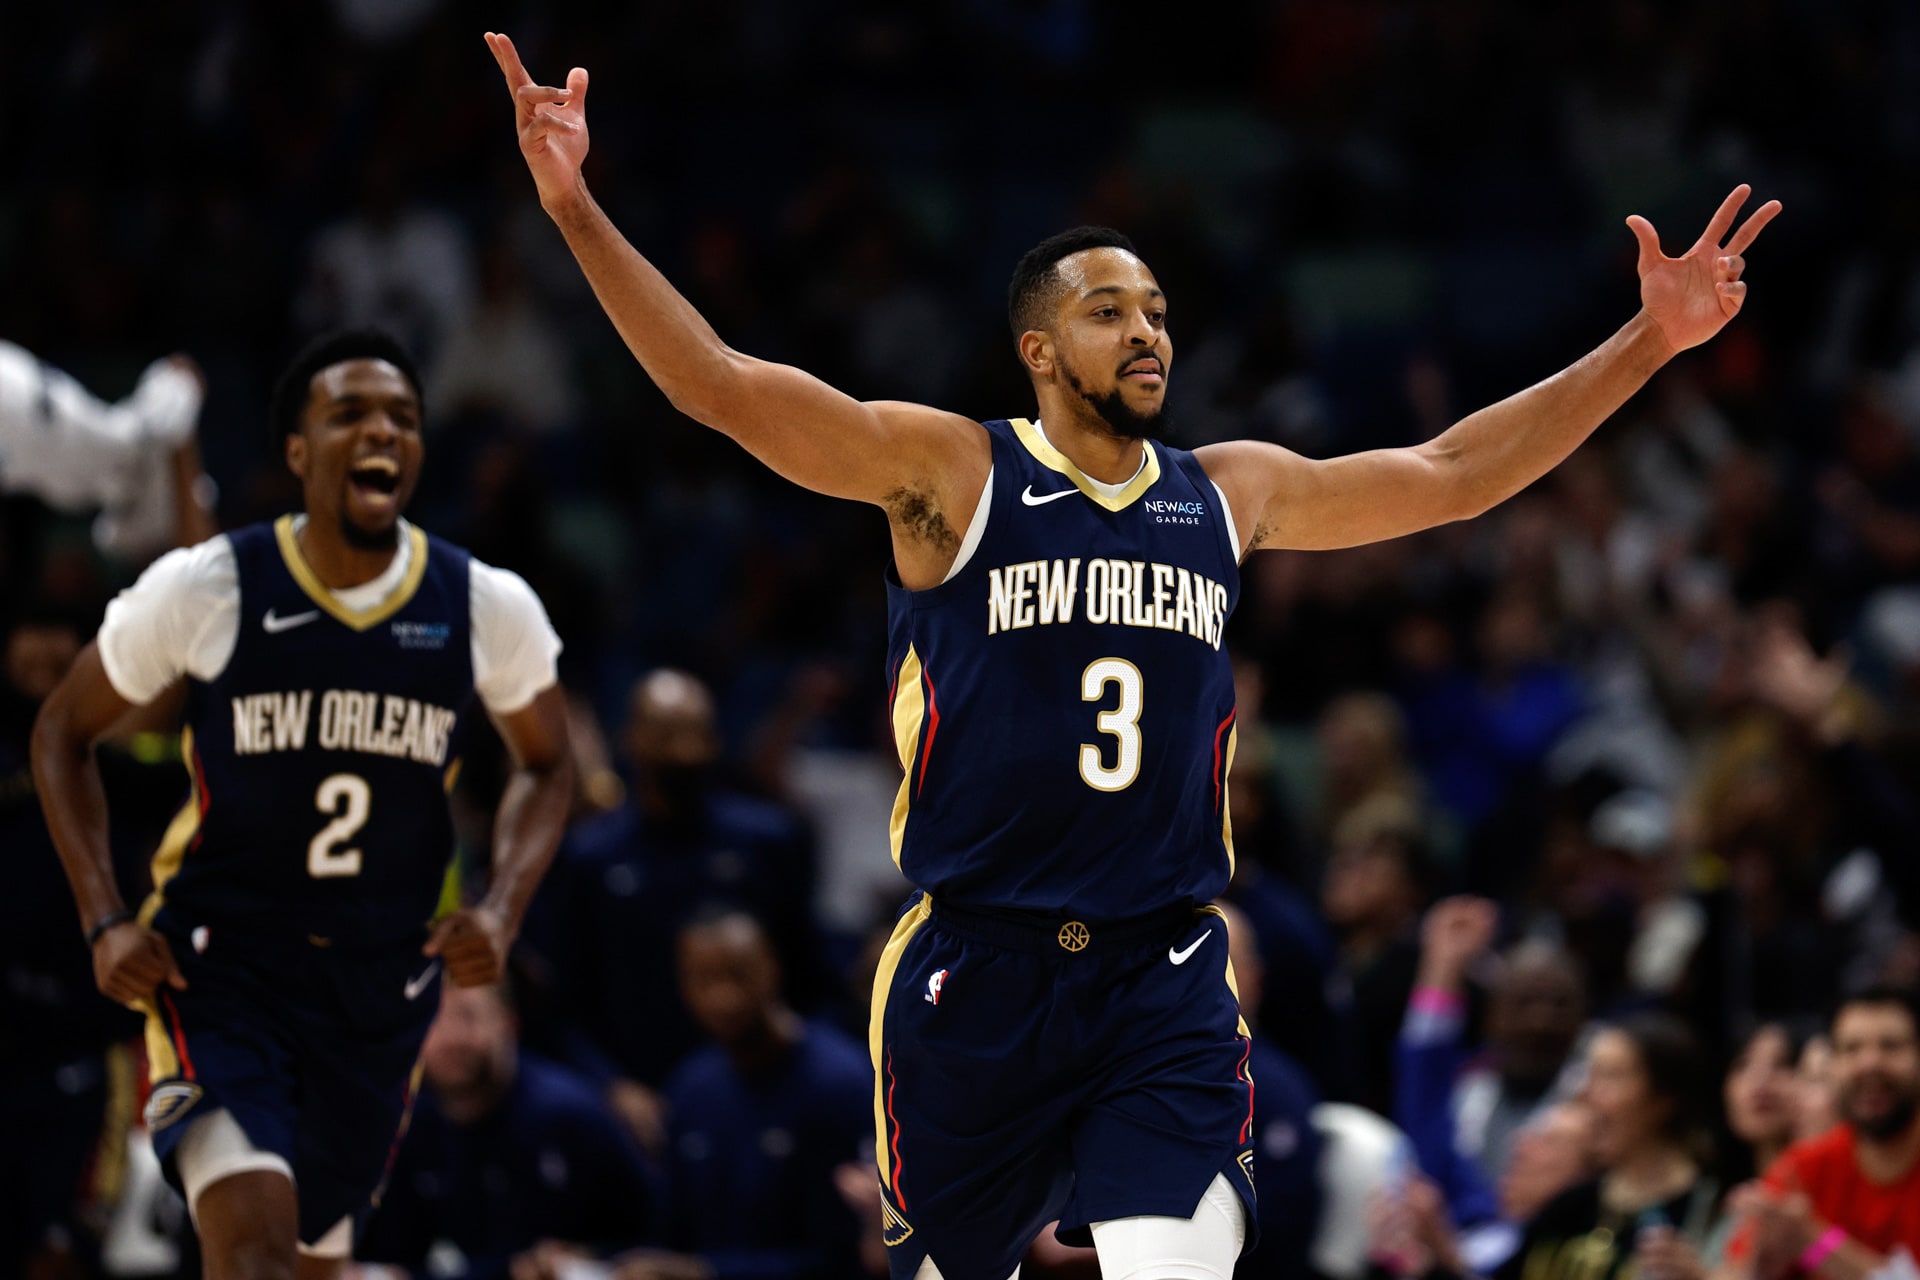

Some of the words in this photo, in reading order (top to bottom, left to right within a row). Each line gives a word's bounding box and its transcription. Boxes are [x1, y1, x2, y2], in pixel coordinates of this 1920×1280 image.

[1144, 500, 1204, 515] NEWAGE
[1156, 516, 1199, 525] GARAGE
[988, 558, 1080, 635] NEW
[1086, 558, 1227, 651] ORLEANS
[231, 689, 314, 755] NEW
[318, 689, 456, 767] ORLEANS
[1078, 657, 1144, 792] 3
[307, 772, 372, 879] 2
